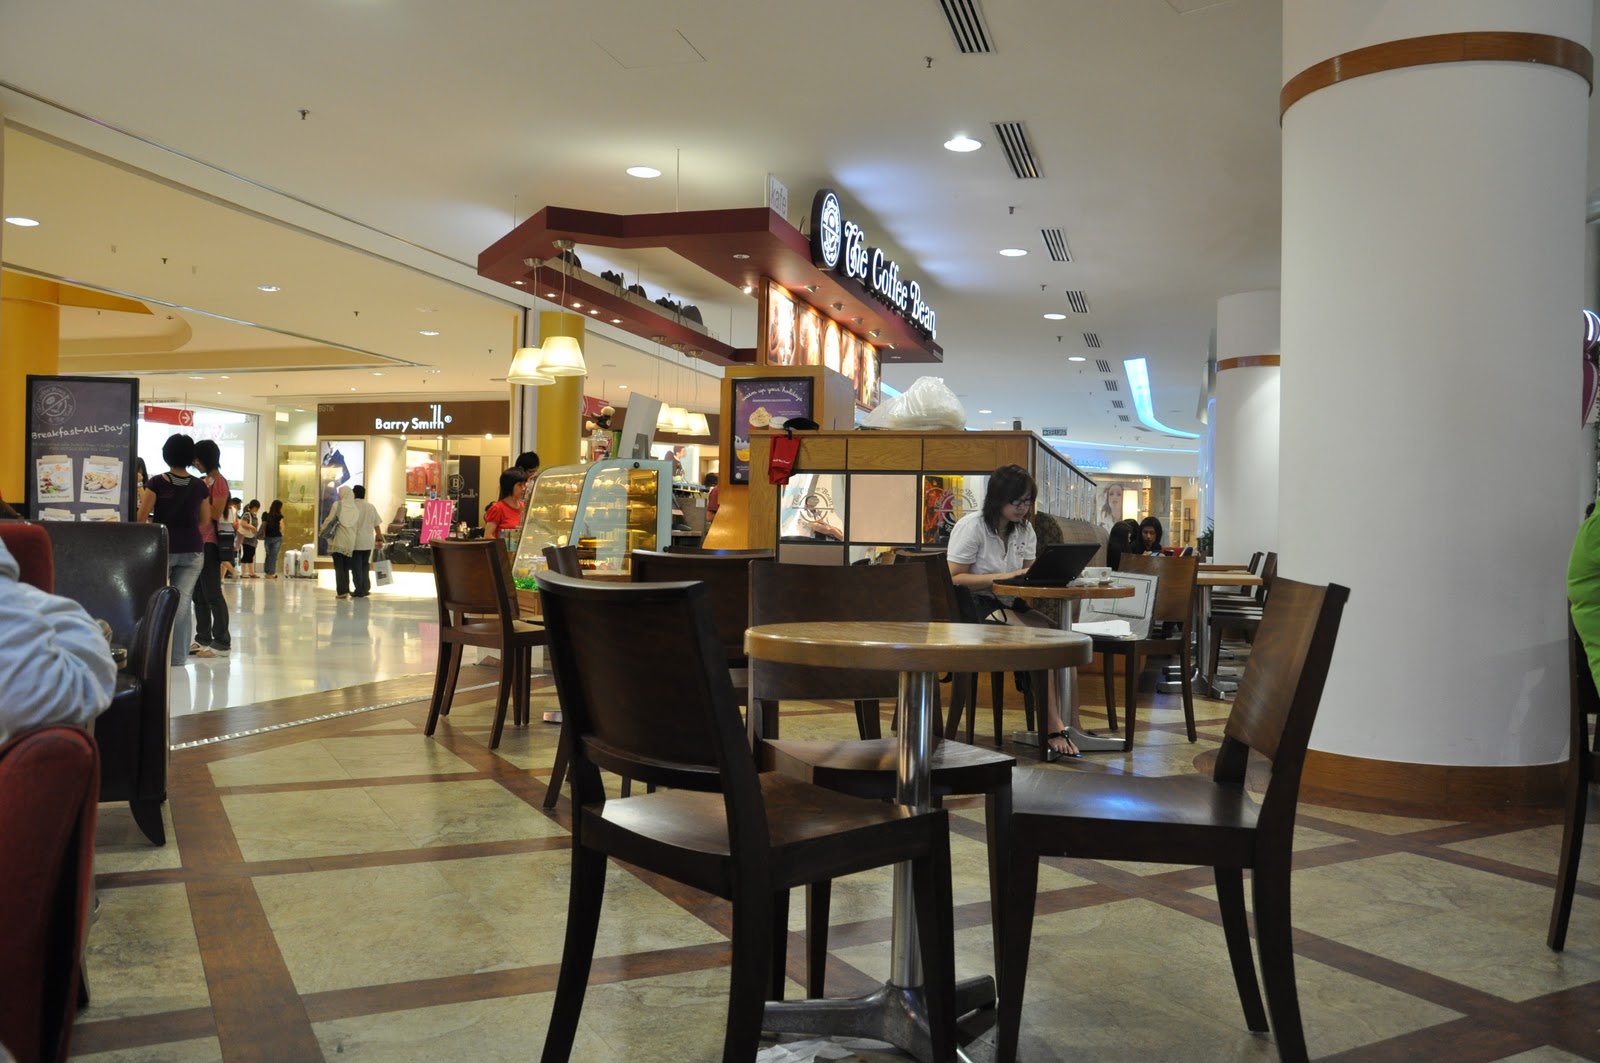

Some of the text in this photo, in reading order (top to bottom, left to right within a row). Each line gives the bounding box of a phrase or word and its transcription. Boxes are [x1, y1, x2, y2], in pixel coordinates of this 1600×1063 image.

[771, 179, 788, 215] kafe
[844, 221, 869, 278] The
[872, 248, 909, 312] Coffee
[910, 280, 937, 341] Bean
[375, 418, 409, 433] Barry
[425, 501, 451, 526] SALE
